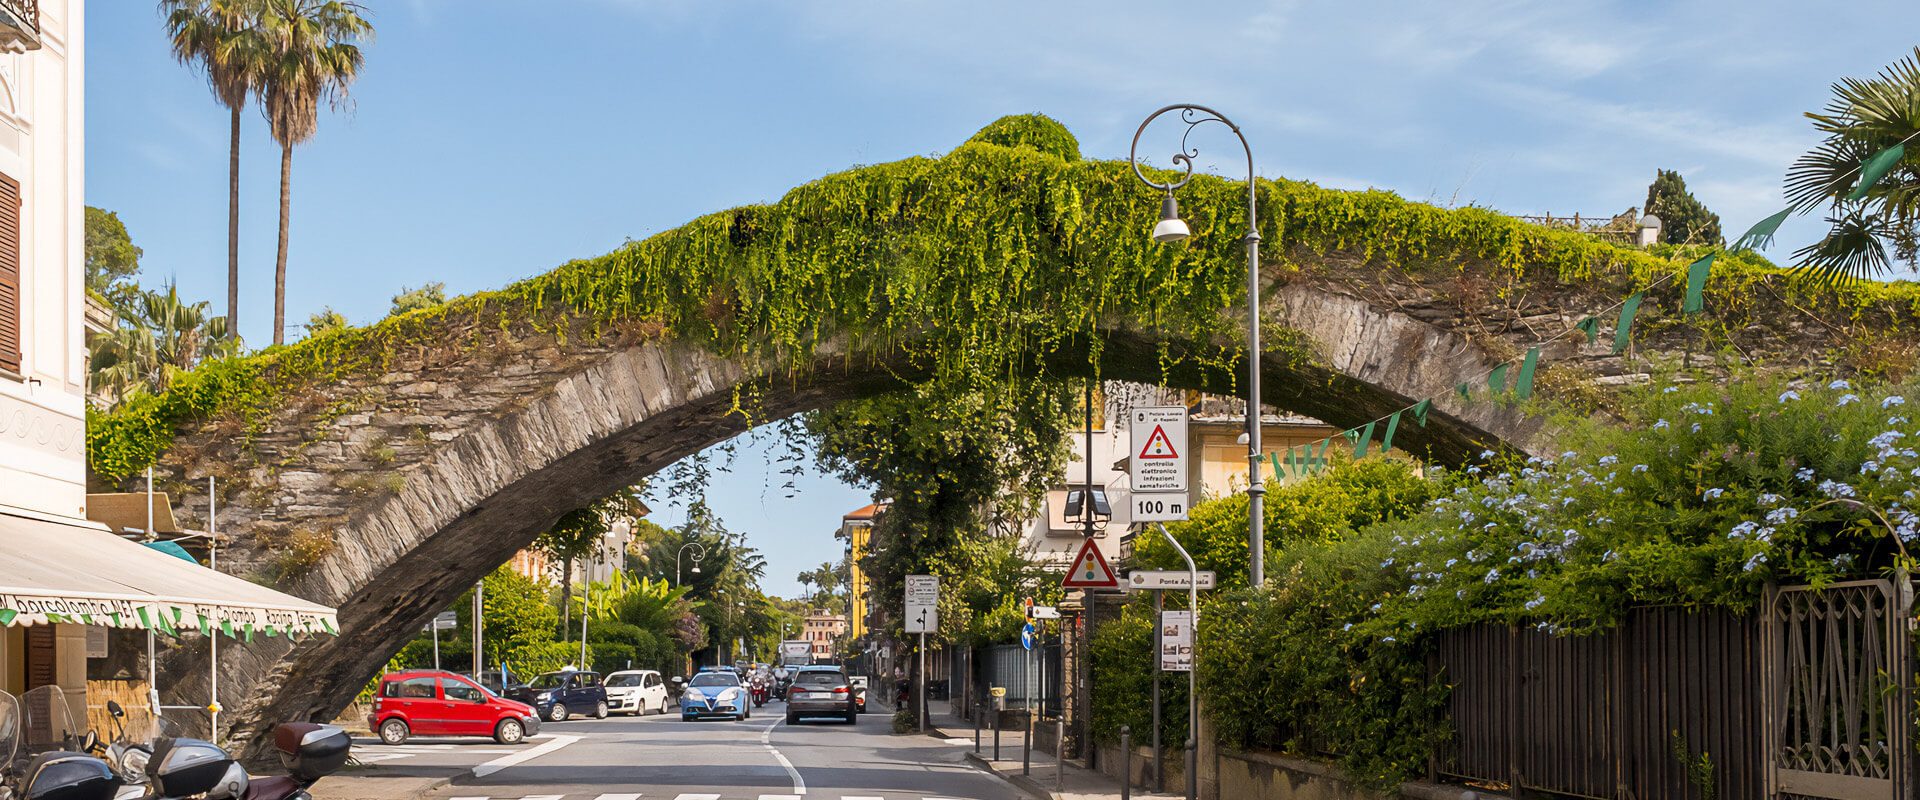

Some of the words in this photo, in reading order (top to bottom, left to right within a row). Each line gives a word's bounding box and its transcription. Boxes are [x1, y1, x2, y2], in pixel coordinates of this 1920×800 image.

[1138, 501, 1163, 514] 100
[1171, 503, 1181, 514] m
[216, 604, 256, 624] Colombo
